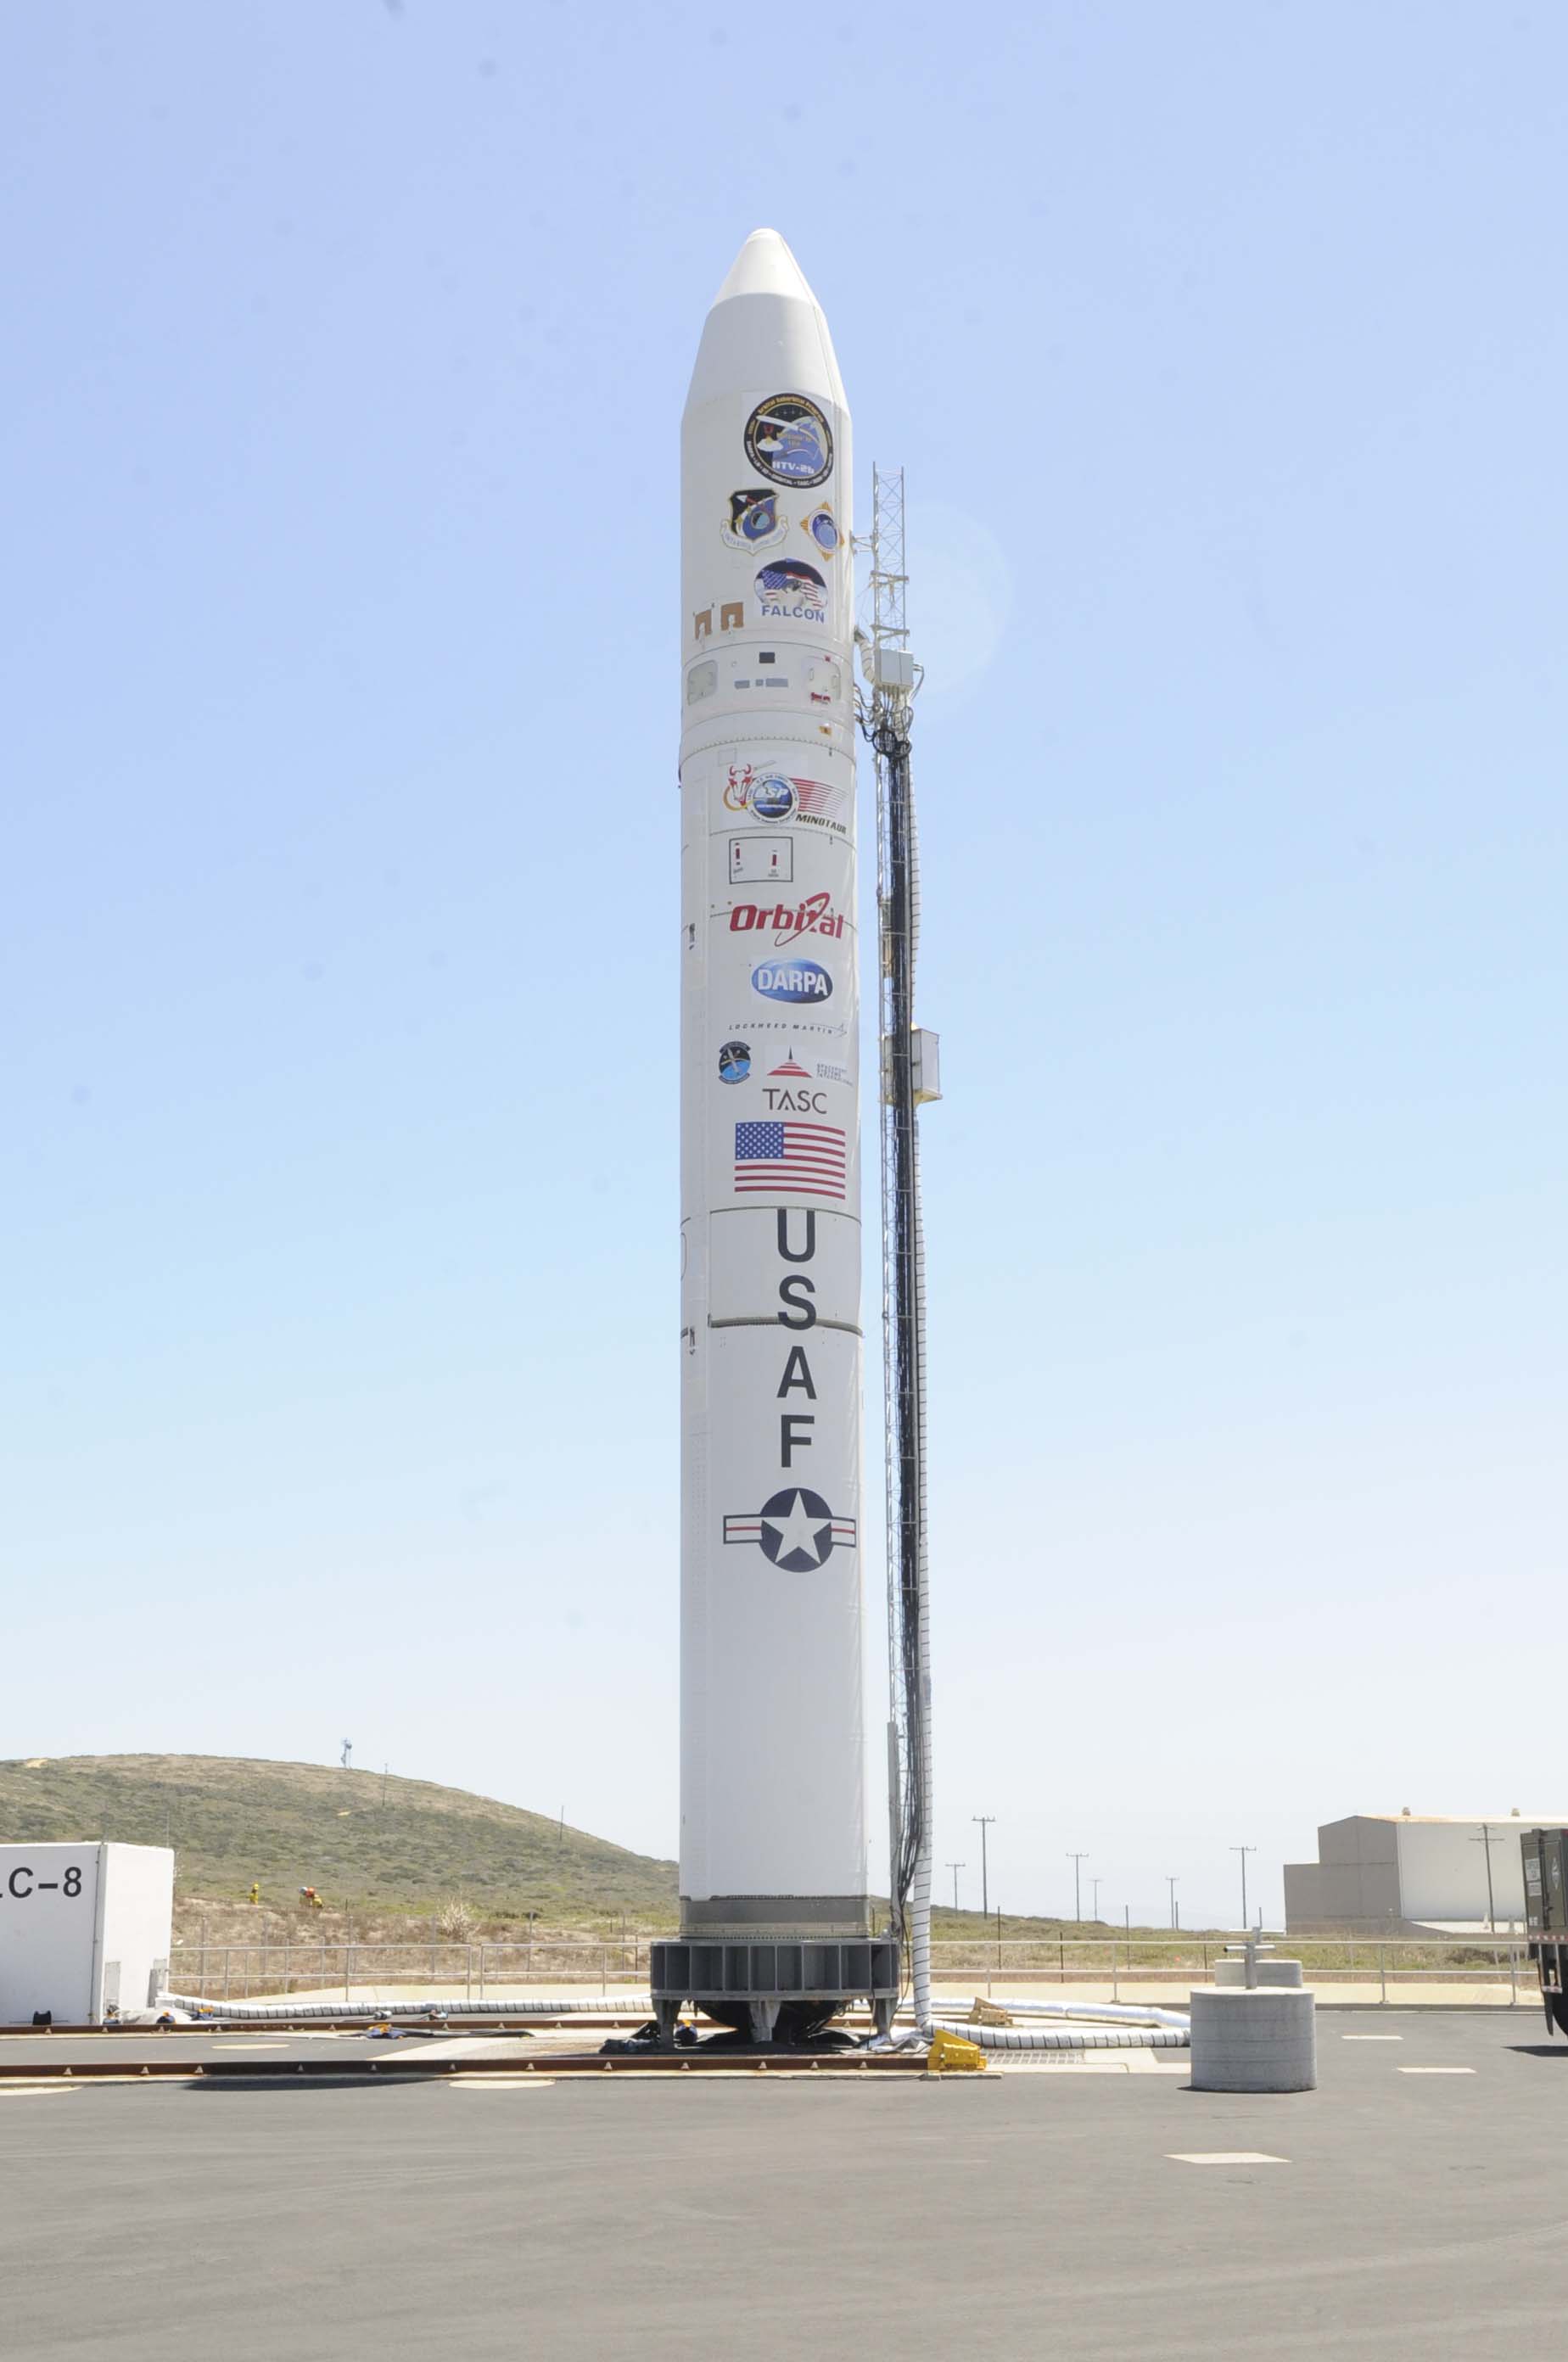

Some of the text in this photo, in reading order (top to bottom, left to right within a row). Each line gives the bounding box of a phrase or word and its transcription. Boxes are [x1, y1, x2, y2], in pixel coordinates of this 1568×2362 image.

[761, 605, 825, 623] FALCON
[796, 814, 847, 834] MINOTAUR
[730, 893, 843, 944] Orbital
[757, 968, 829, 996] DARPA
[729, 1022, 787, 1031] LOCKHEED
[762, 1089, 827, 1114] TASC
[776, 1208, 817, 1468] USAF
[0, 1867, 82, 1899] C-8
